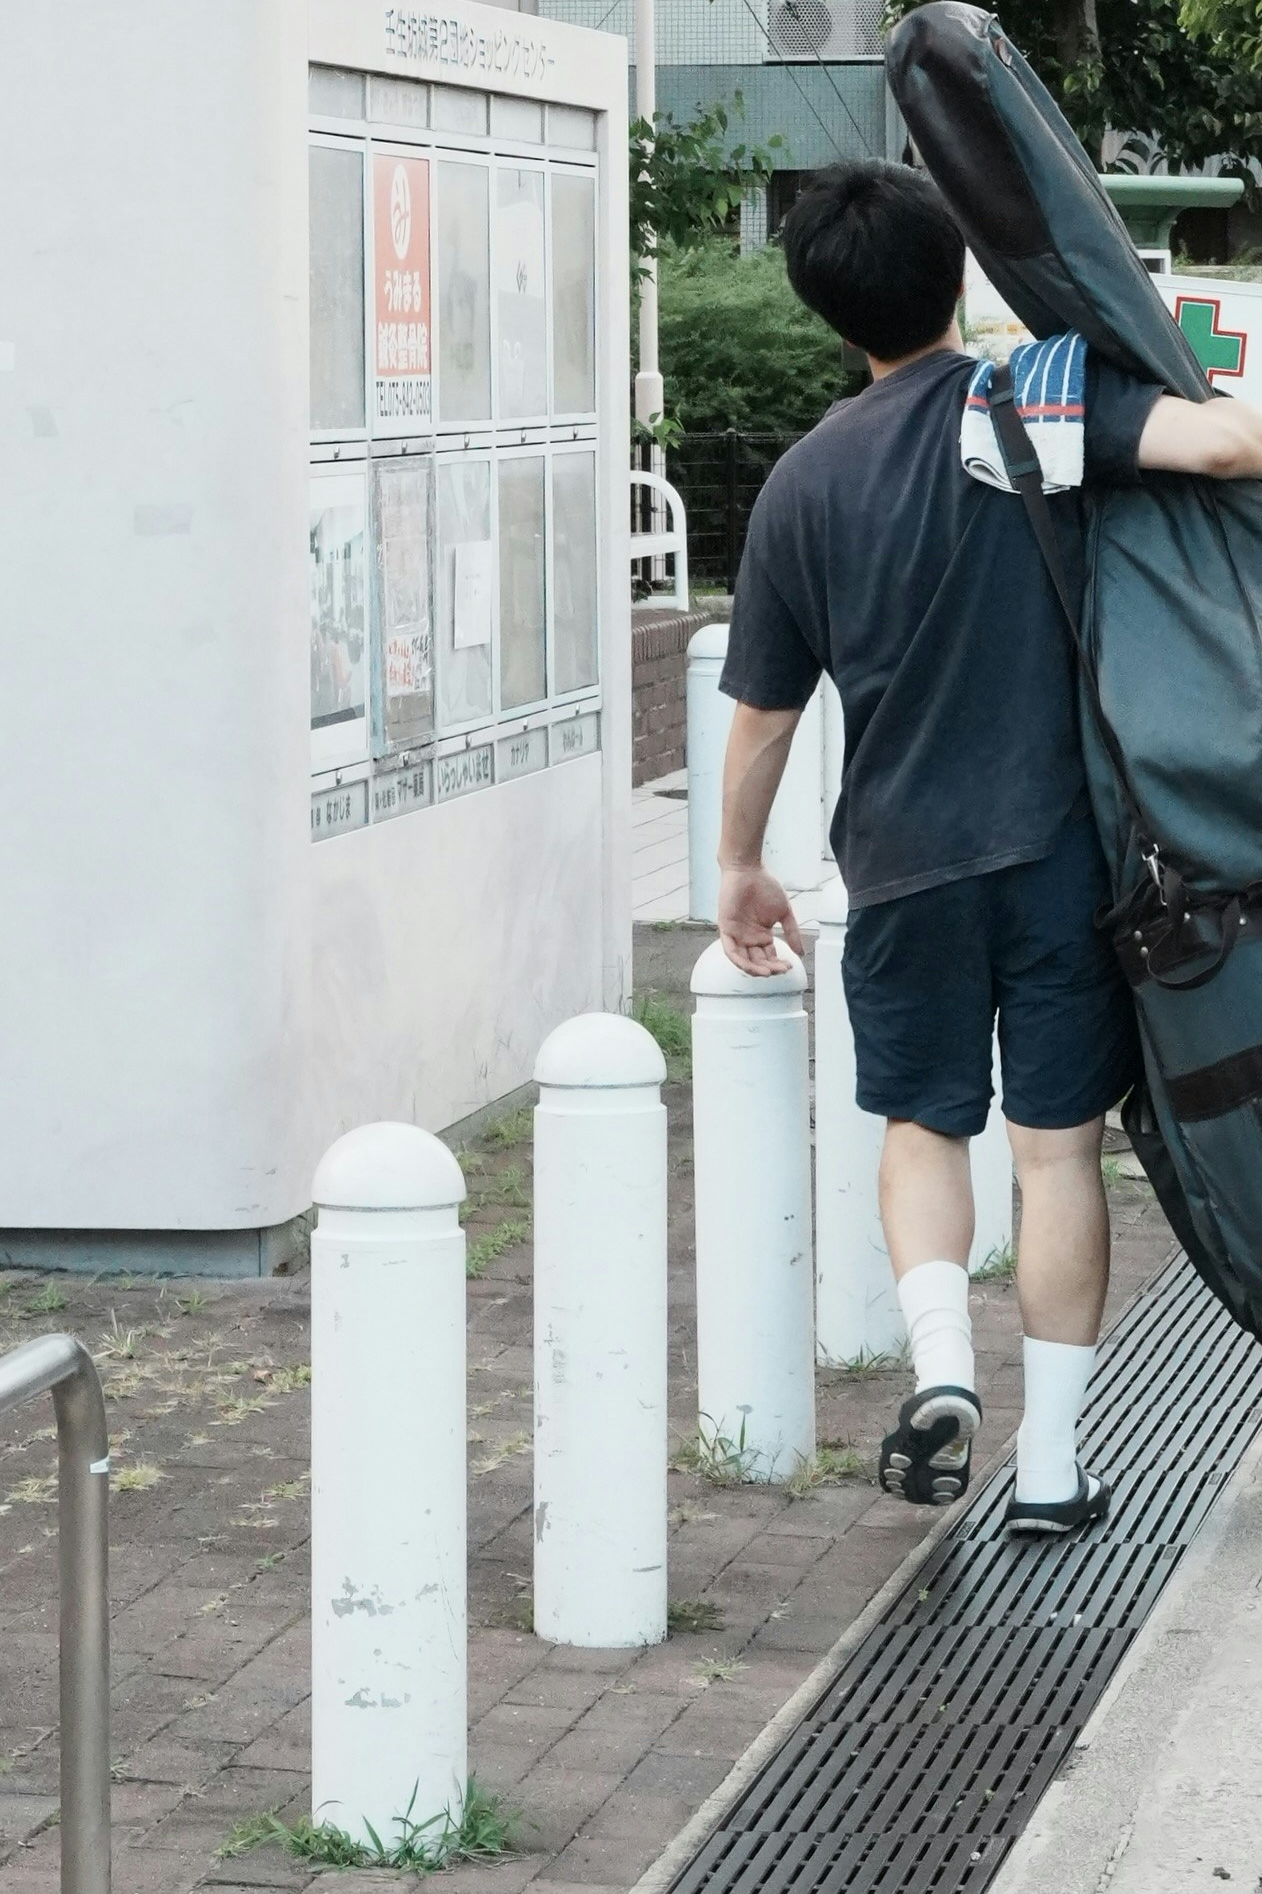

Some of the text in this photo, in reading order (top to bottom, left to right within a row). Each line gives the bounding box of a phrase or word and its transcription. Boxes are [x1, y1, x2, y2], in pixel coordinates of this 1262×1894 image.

[383, 269, 422, 313] うみまる
[376, 321, 428, 370] 鍼灸整骨院
